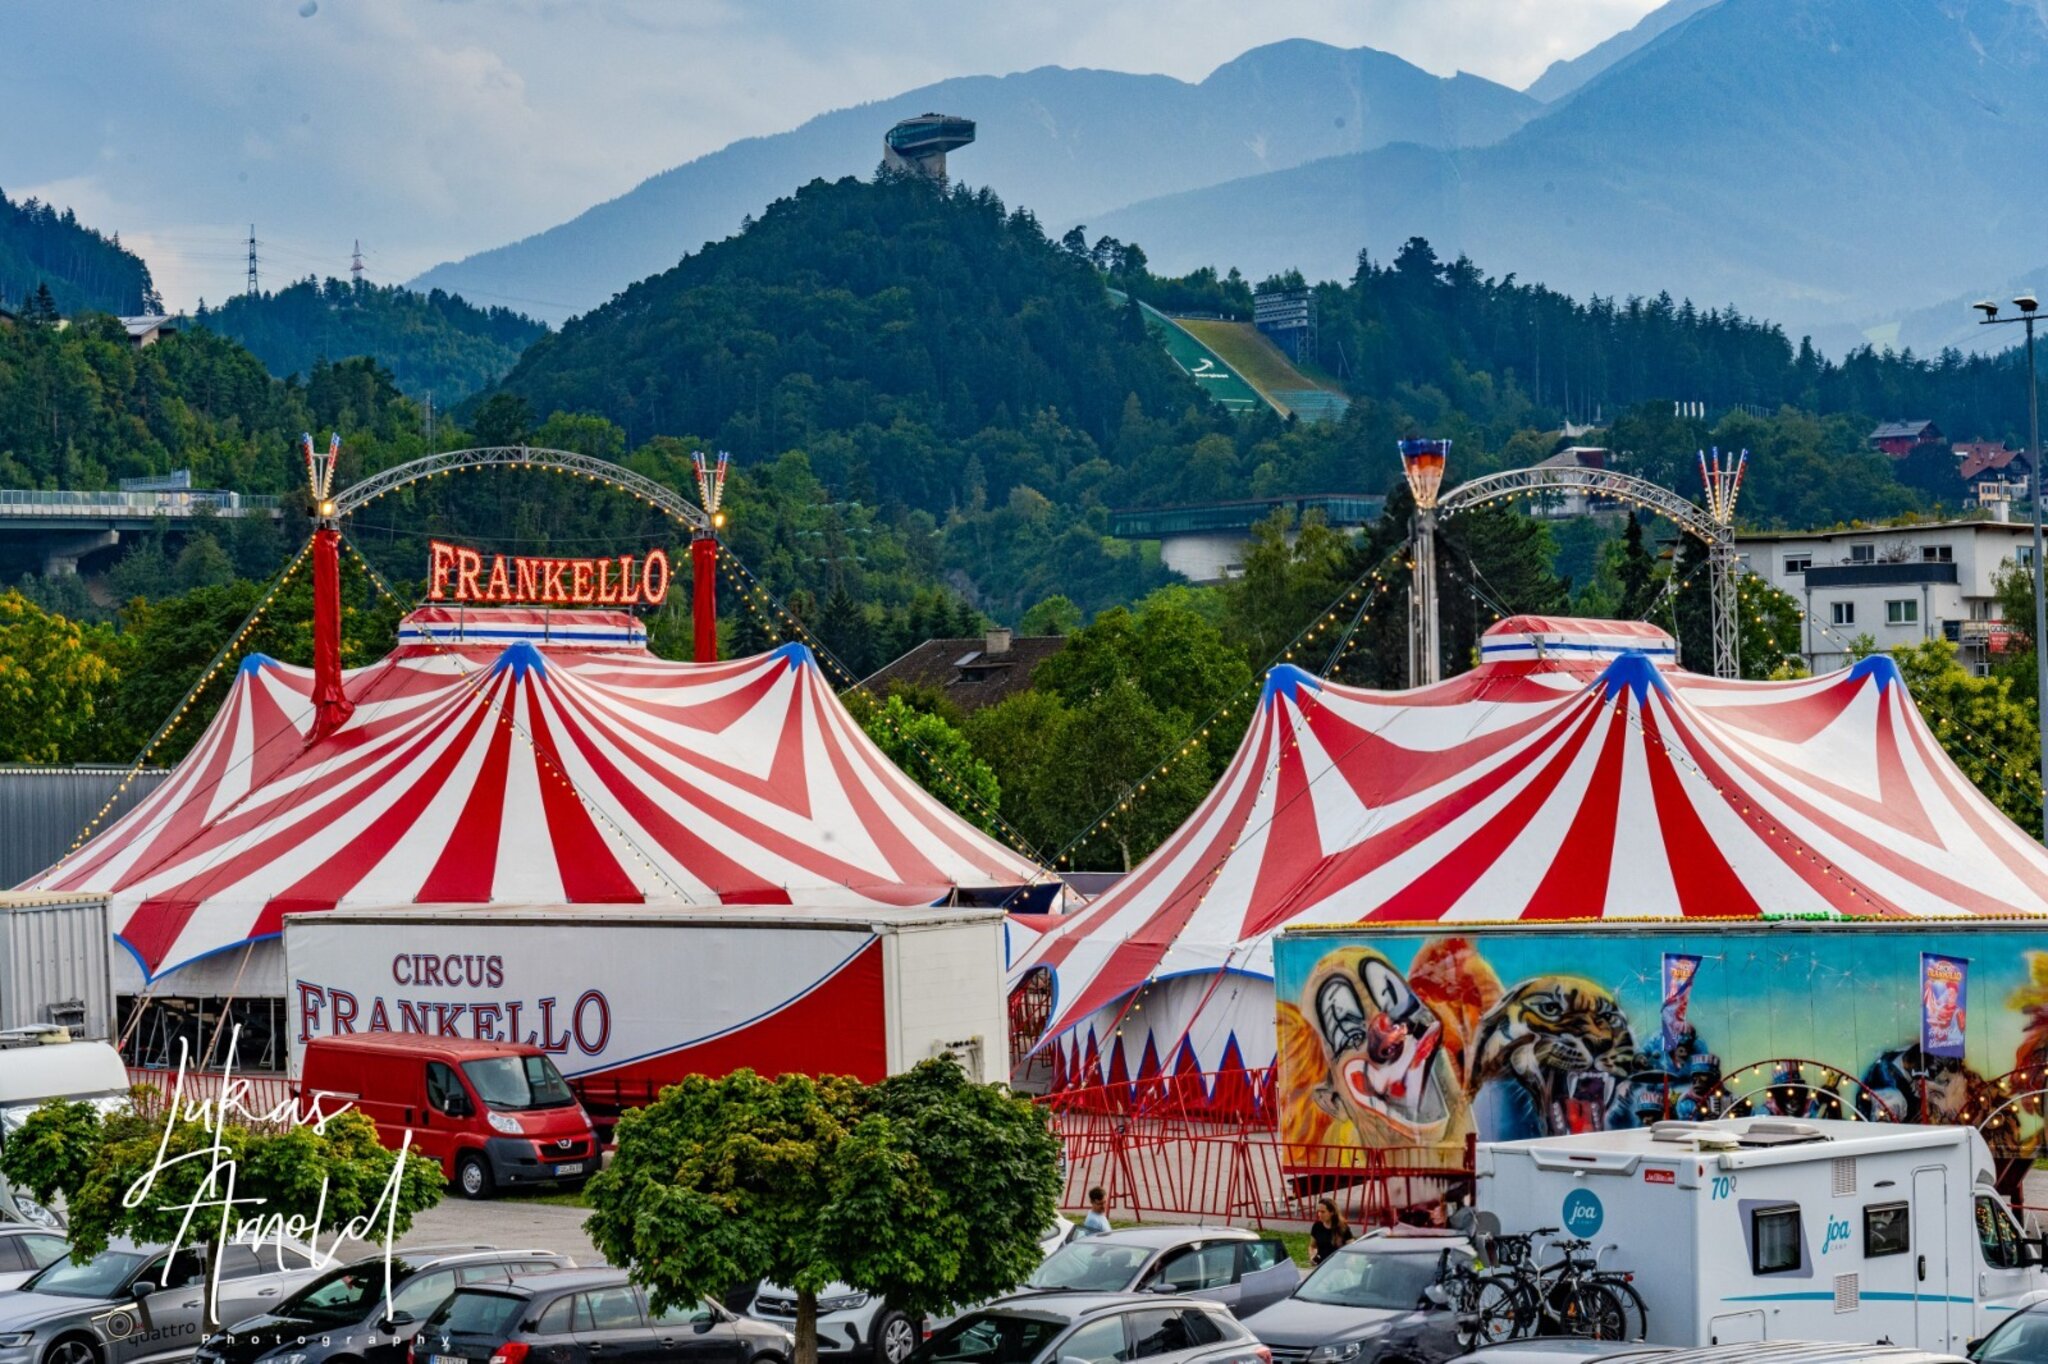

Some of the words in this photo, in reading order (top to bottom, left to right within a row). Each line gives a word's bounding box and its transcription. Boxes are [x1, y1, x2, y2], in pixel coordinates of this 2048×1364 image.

[430, 539, 670, 604] FRANKELLO
[392, 953, 504, 988] CIRCUS
[296, 979, 612, 1056] FRANKELLO
[1568, 1200, 1597, 1225] joa
[1822, 1214, 1851, 1255] joa
[127, 1321, 196, 1348] quattro
